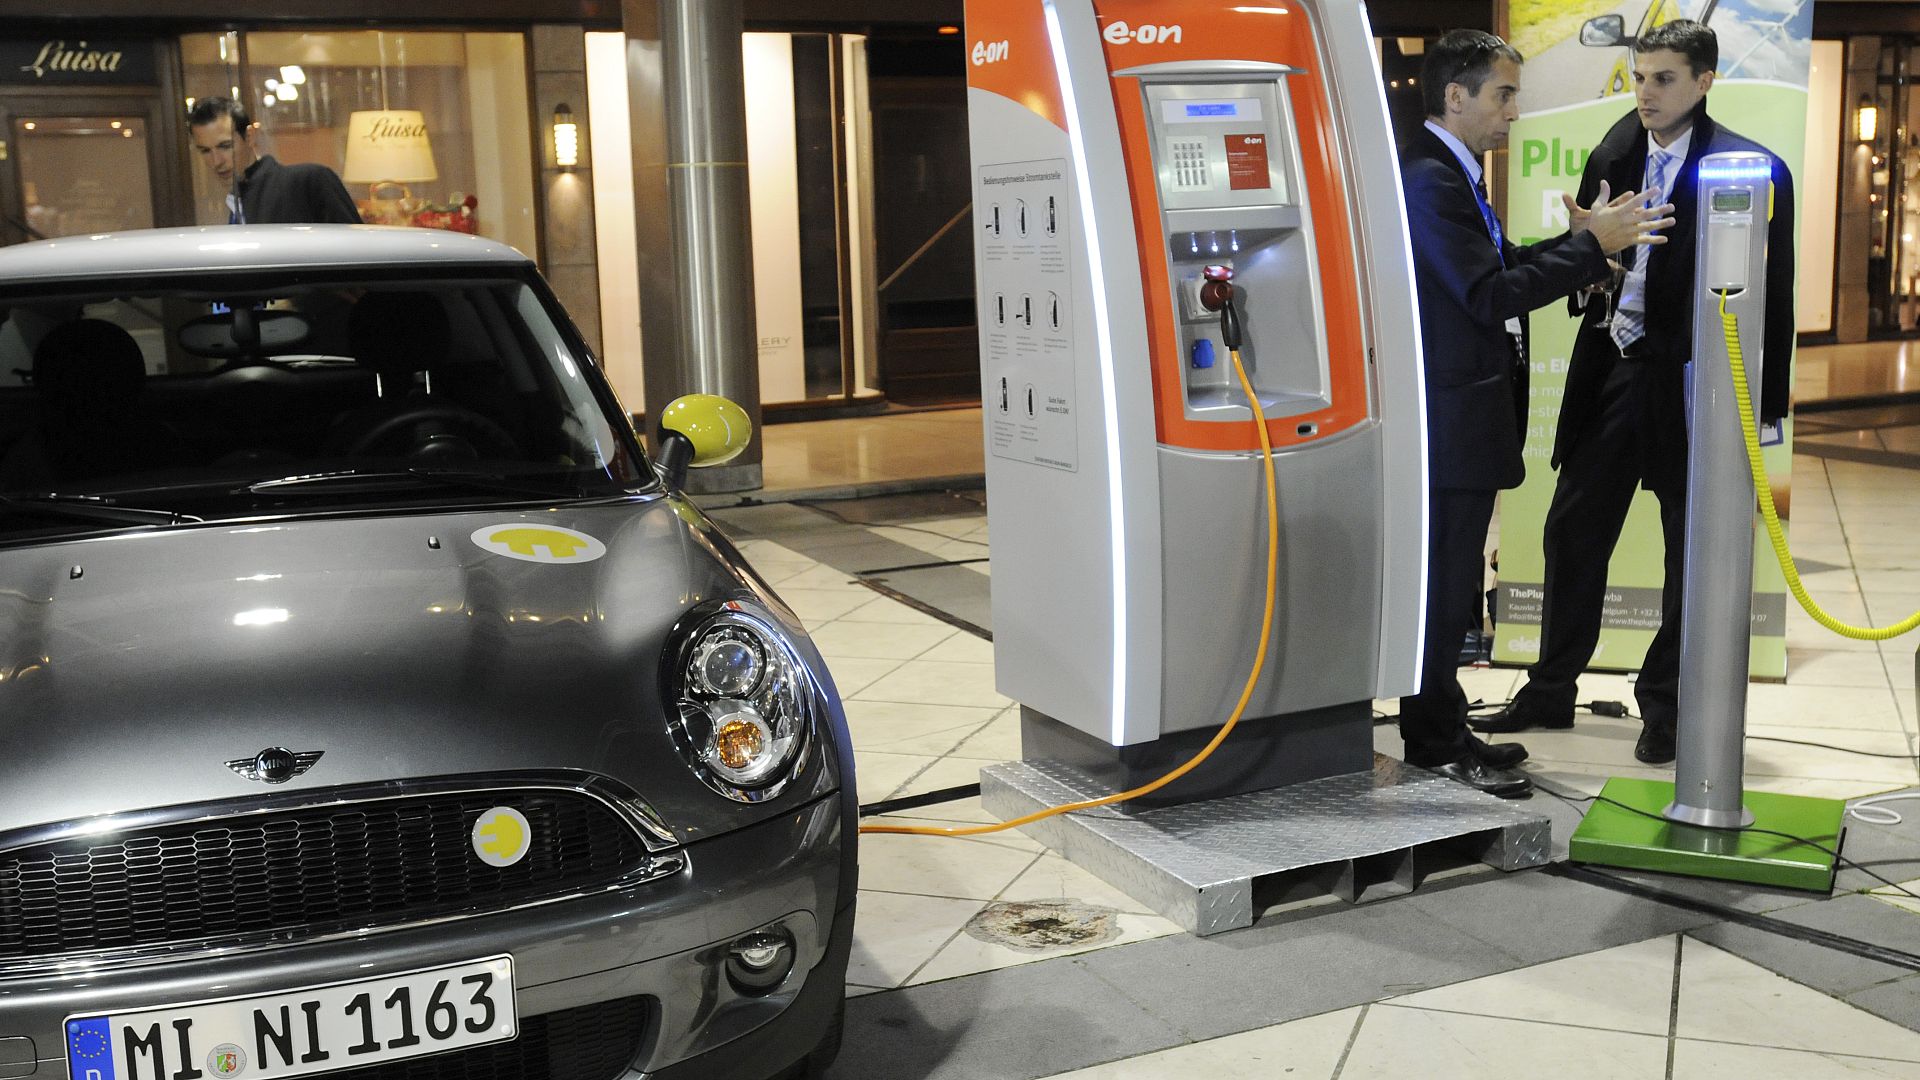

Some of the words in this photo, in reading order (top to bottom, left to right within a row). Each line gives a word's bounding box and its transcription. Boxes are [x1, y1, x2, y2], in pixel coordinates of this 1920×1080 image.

[20, 40, 122, 78] Luisa
[363, 117, 426, 142] Luisa
[260, 757, 292, 771] MINI
[123, 1018, 203, 1080] MI
[253, 1000, 330, 1070] NI
[345, 972, 496, 1056] 1163
